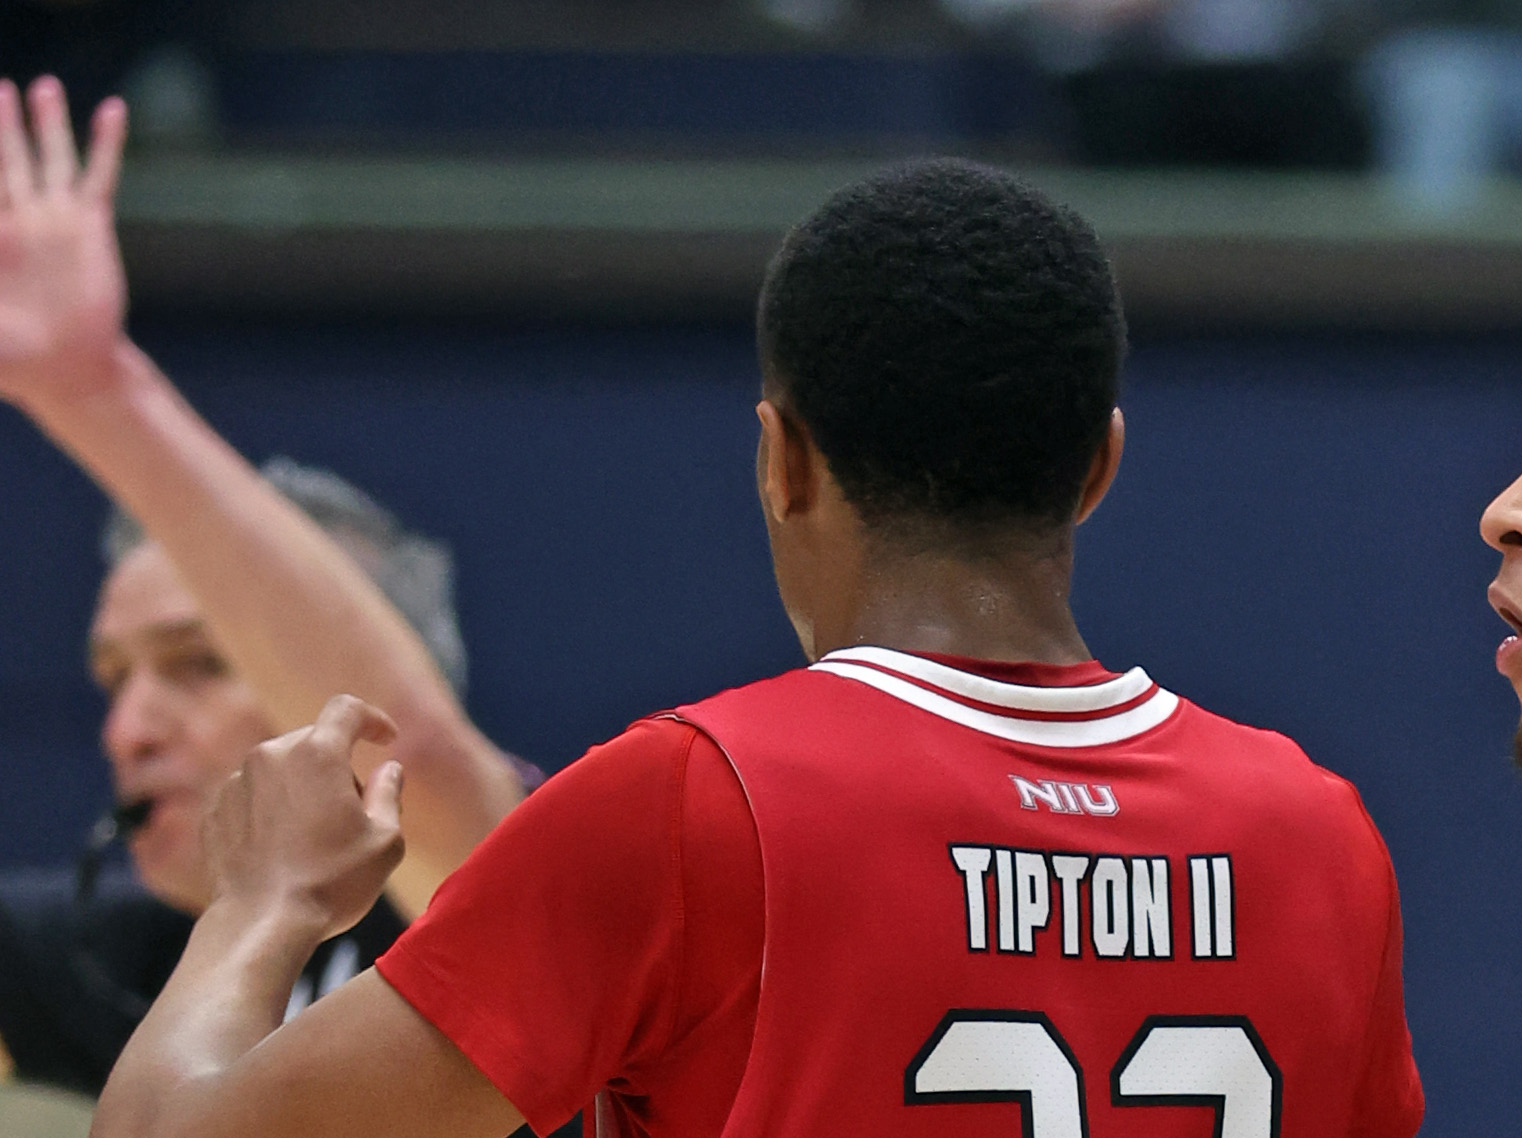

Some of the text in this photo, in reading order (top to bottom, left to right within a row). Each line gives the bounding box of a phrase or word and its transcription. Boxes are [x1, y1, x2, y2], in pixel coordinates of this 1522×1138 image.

[1008, 774, 1120, 816] NIU
[948, 842, 1237, 961] TIPTON II
